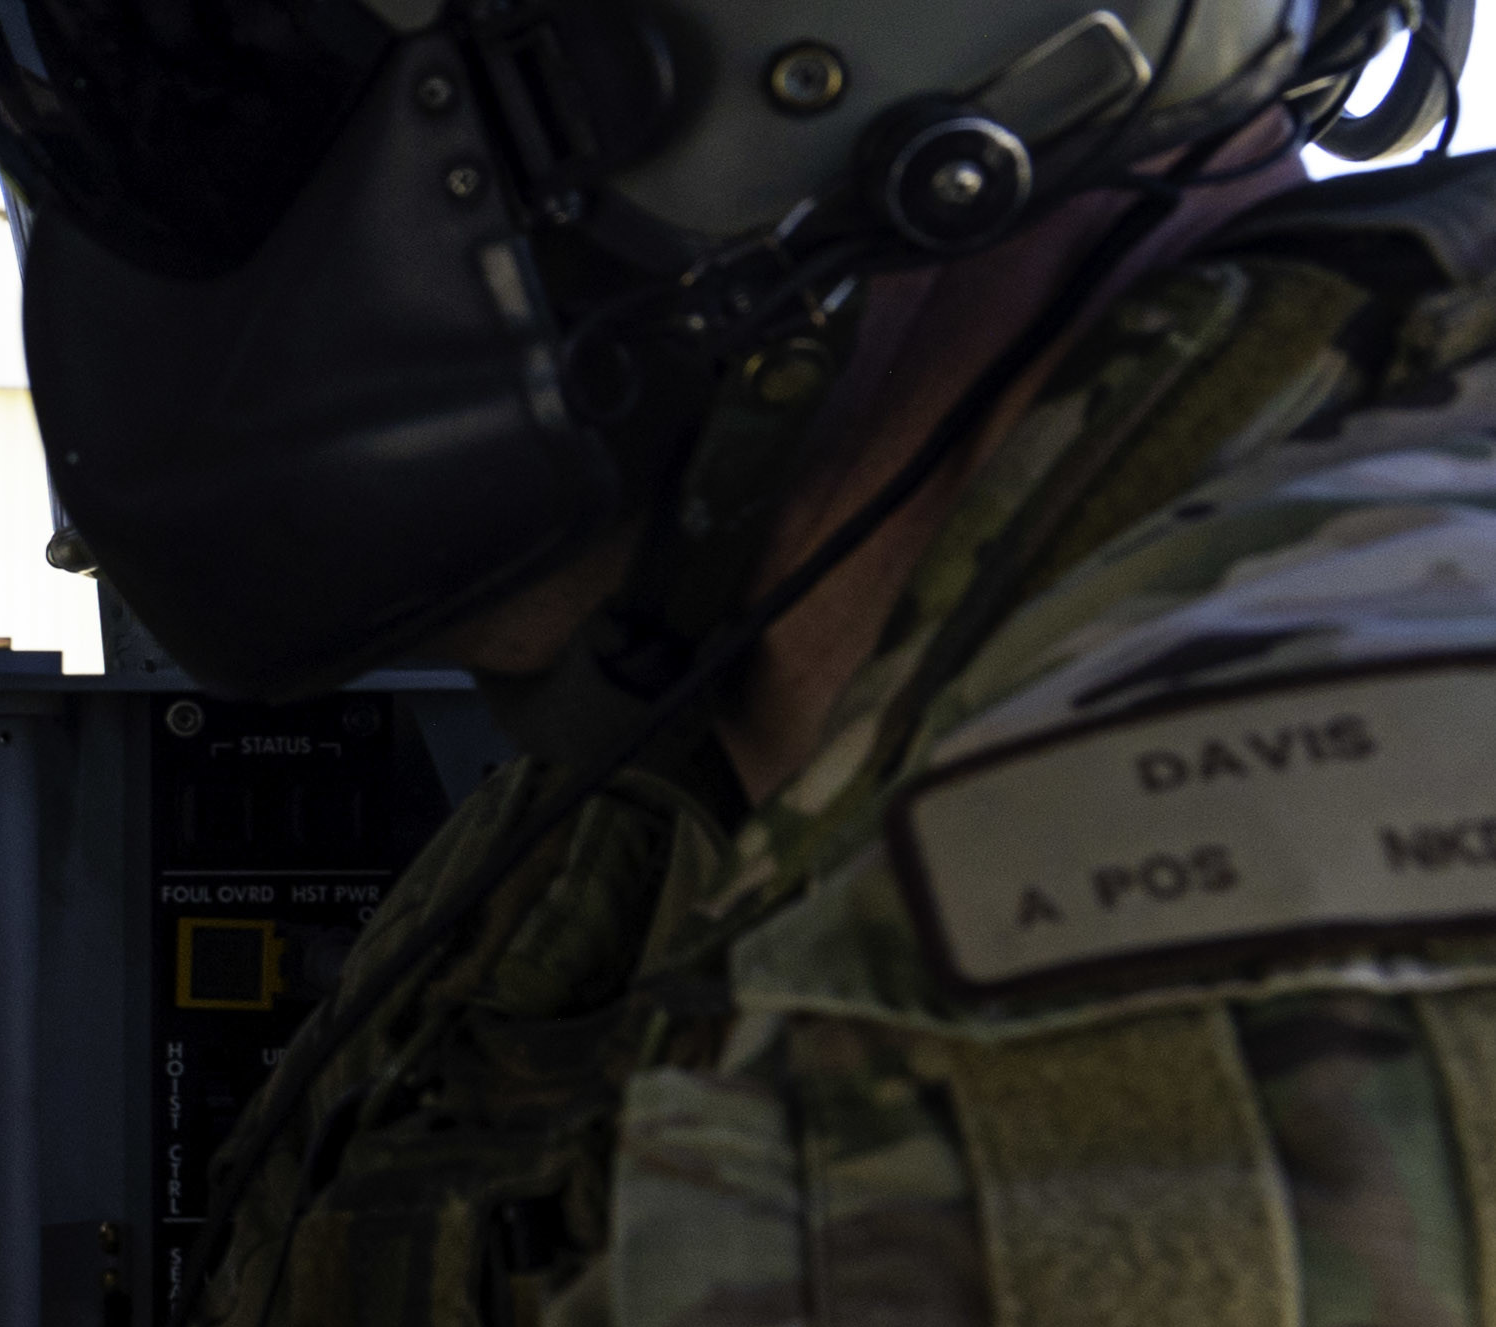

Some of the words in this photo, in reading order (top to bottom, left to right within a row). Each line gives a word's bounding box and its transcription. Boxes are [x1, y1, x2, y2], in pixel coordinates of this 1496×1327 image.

[240, 735, 313, 755] STATUS
[1135, 714, 1377, 794] DAVIS
[161, 885, 212, 903] FOUL
[217, 885, 275, 904] OVRD
[290, 885, 329, 903] HST
[334, 885, 380, 903] PWR
[1014, 887, 1064, 931] A
[1093, 845, 1240, 909] POS
[166, 1041, 184, 1130] HOIST
[167, 1144, 183, 1215] CTRL
